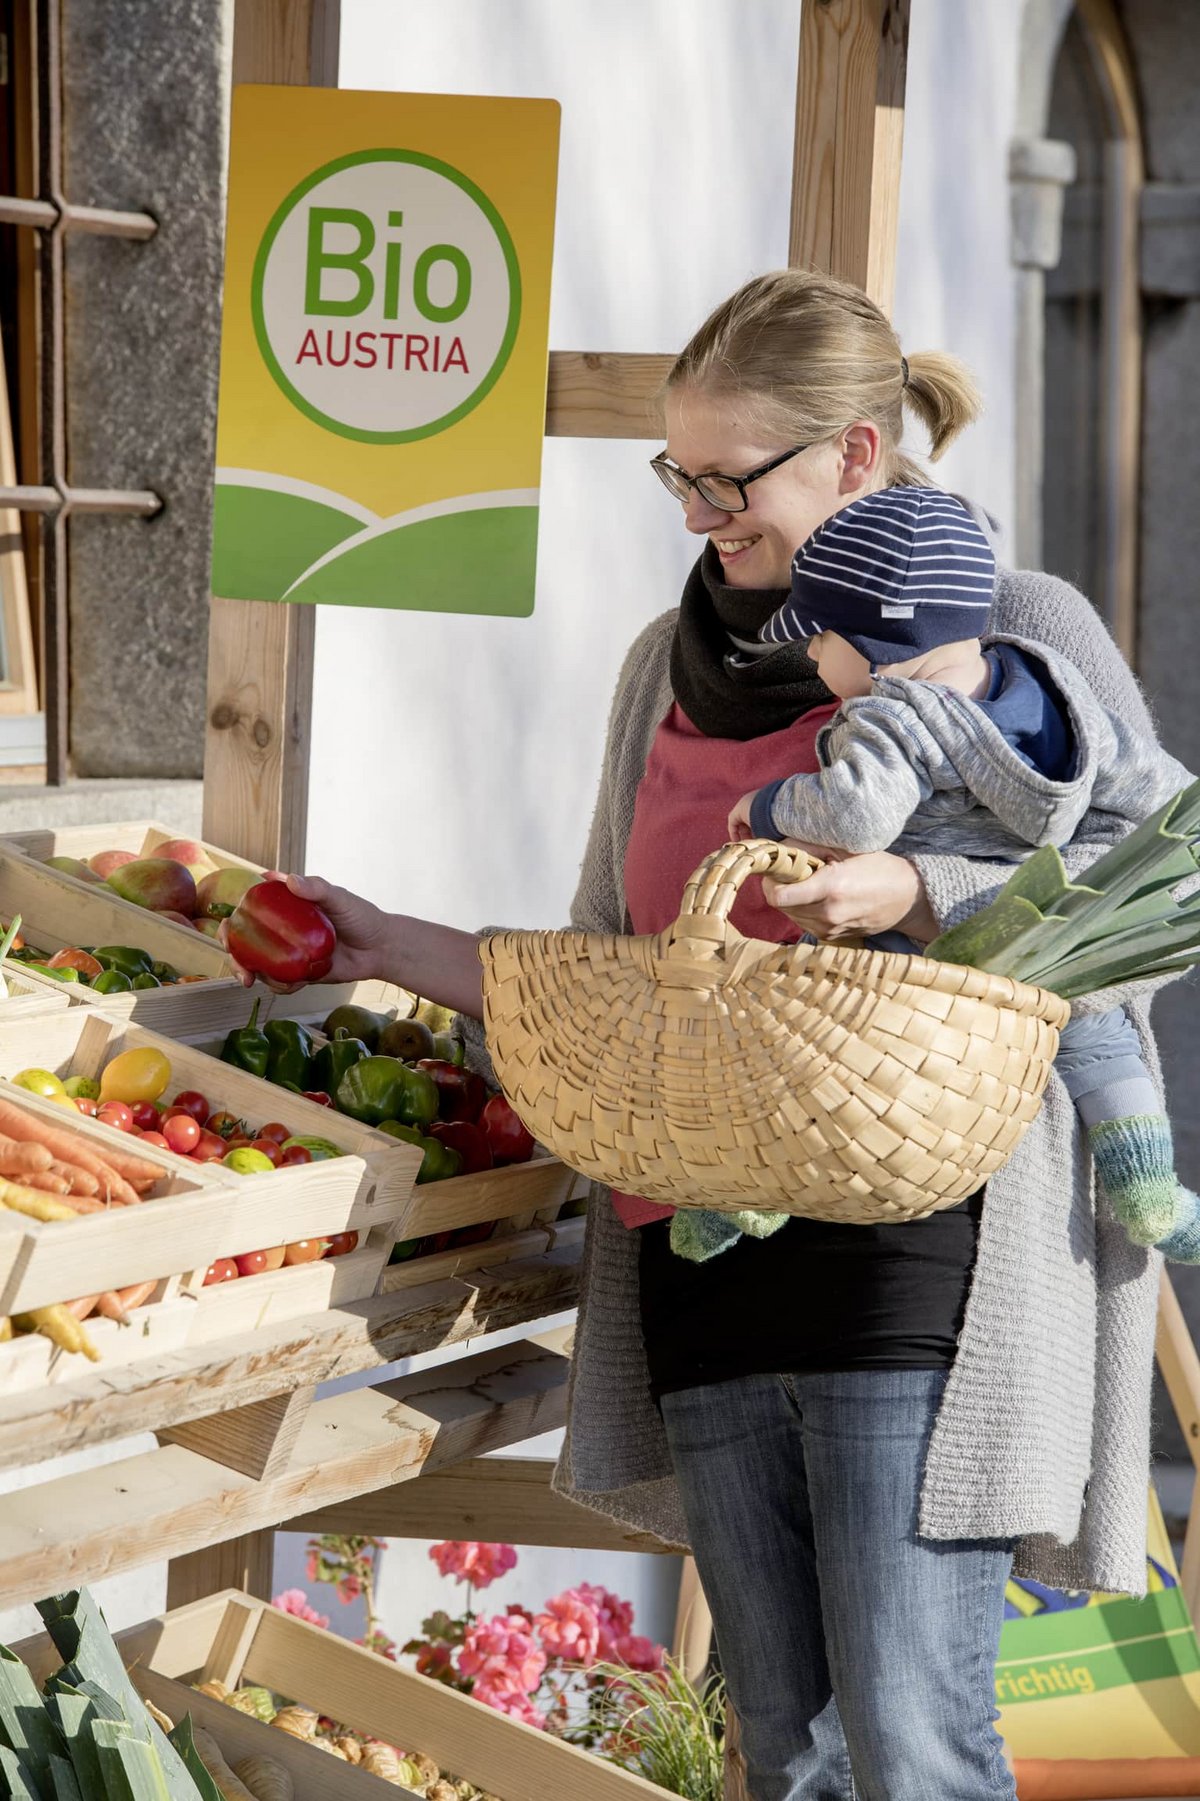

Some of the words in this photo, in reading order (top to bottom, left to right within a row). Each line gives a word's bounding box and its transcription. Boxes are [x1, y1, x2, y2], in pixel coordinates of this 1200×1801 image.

[303, 206, 472, 323] Bio
[296, 329, 470, 374] AUSTRIA
[994, 1663, 1095, 1699] richtig
